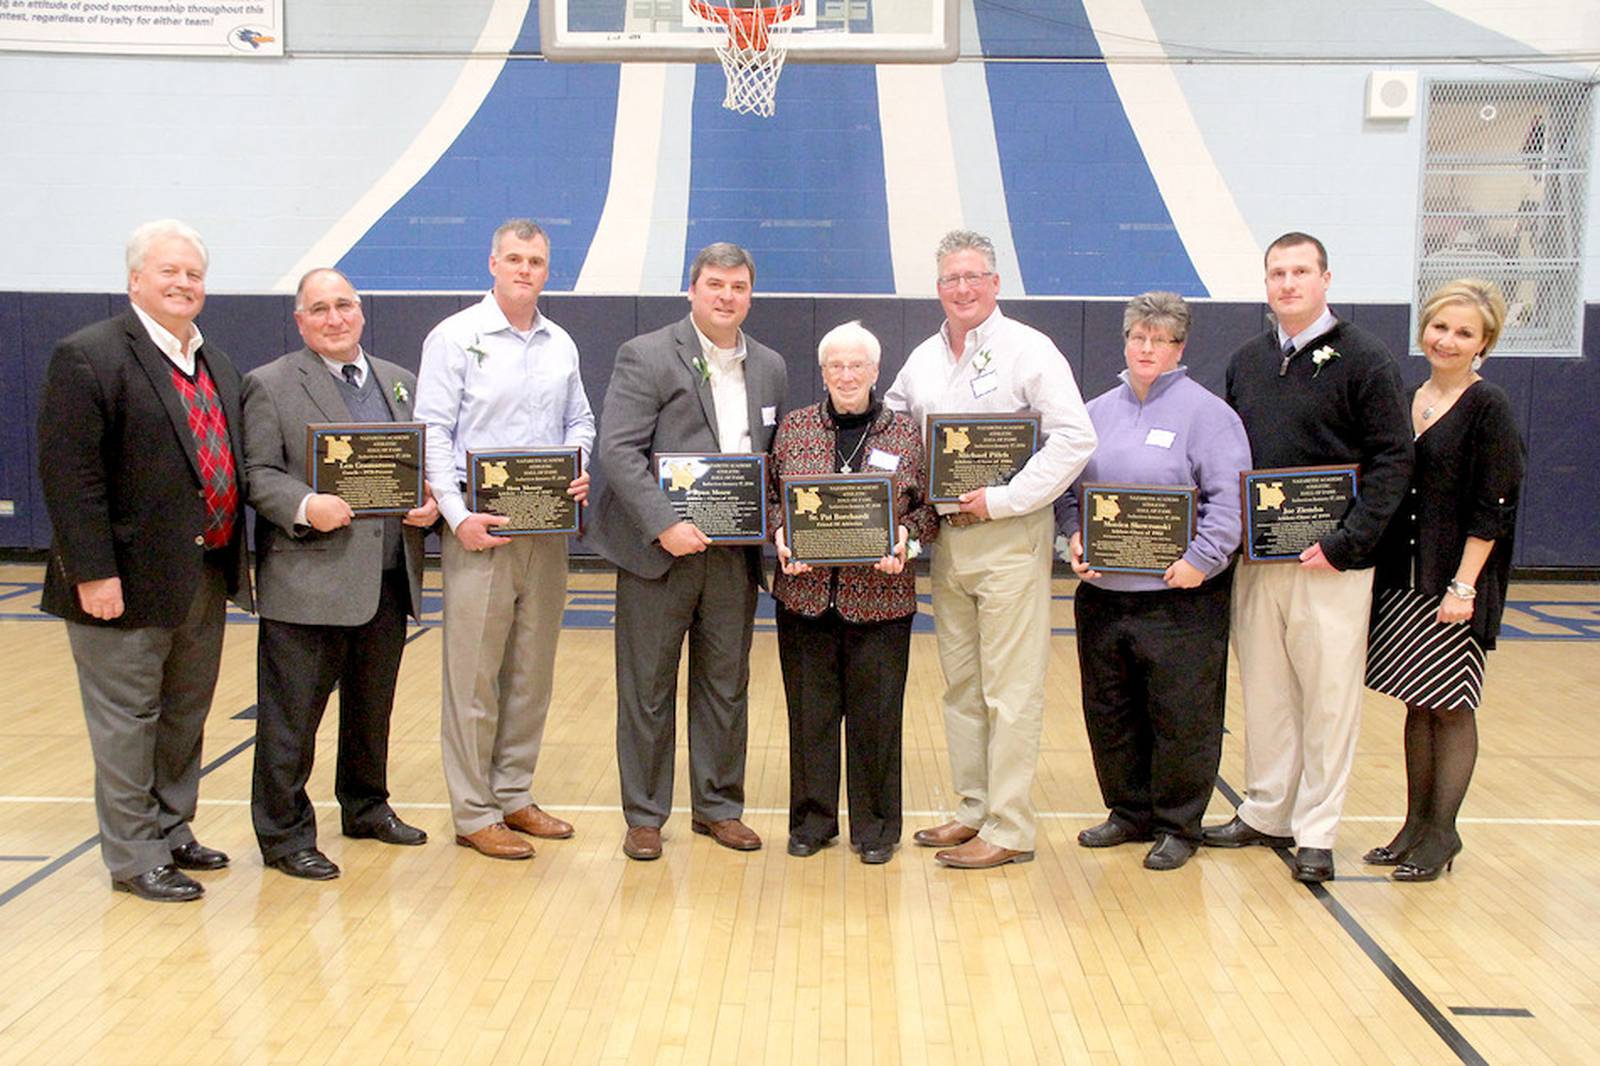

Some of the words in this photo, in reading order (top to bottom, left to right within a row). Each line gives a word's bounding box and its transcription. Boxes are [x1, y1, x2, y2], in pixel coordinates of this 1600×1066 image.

[12, 0, 25, 8] an
[27, 1, 68, 10] attitude
[70, 1, 81, 11] of
[83, 3, 109, 12] good
[111, 3, 185, 14] sportsmanship
[187, 5, 243, 15] throughout
[245, 5, 264, 14] this
[31, 14, 84, 23] regardless
[87, 15, 98, 24] of
[100, 16, 133, 26] loyalty
[136, 16, 151, 24] for
[153, 17, 182, 25] either
